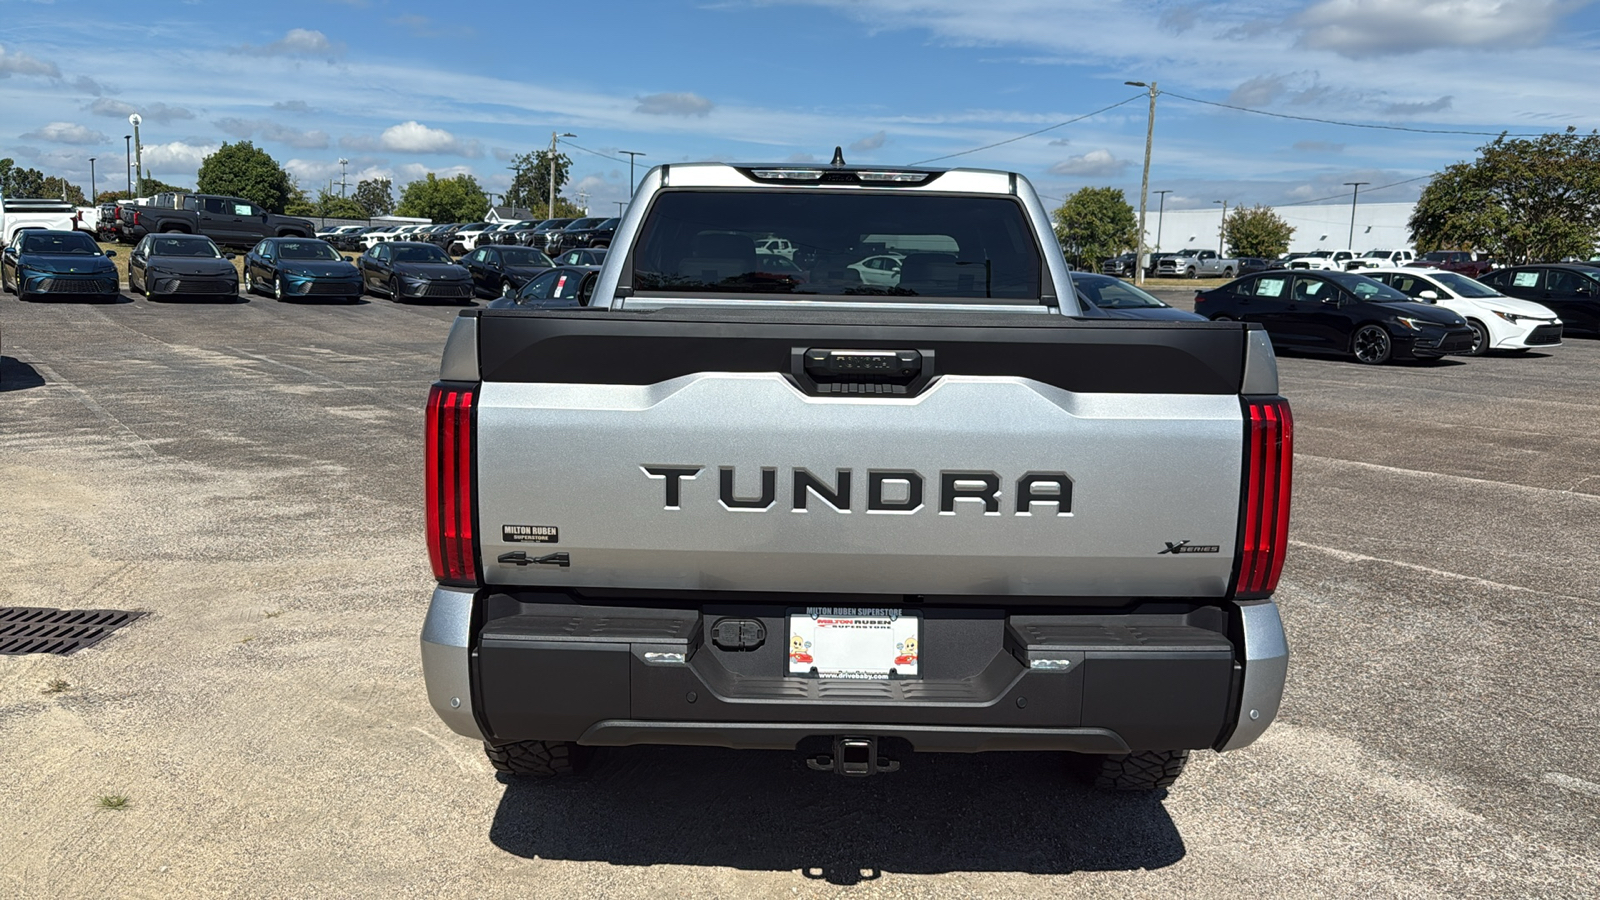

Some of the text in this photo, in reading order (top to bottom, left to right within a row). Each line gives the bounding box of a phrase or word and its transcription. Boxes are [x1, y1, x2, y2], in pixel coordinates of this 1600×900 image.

[639, 464, 1075, 517] TUNDRA
[504, 526, 557, 536] MILTON RUBEN
[806, 607, 902, 617] MILTON RUBEN SUPERSTORE
[819, 672, 889, 680] www.drivebaby.com
